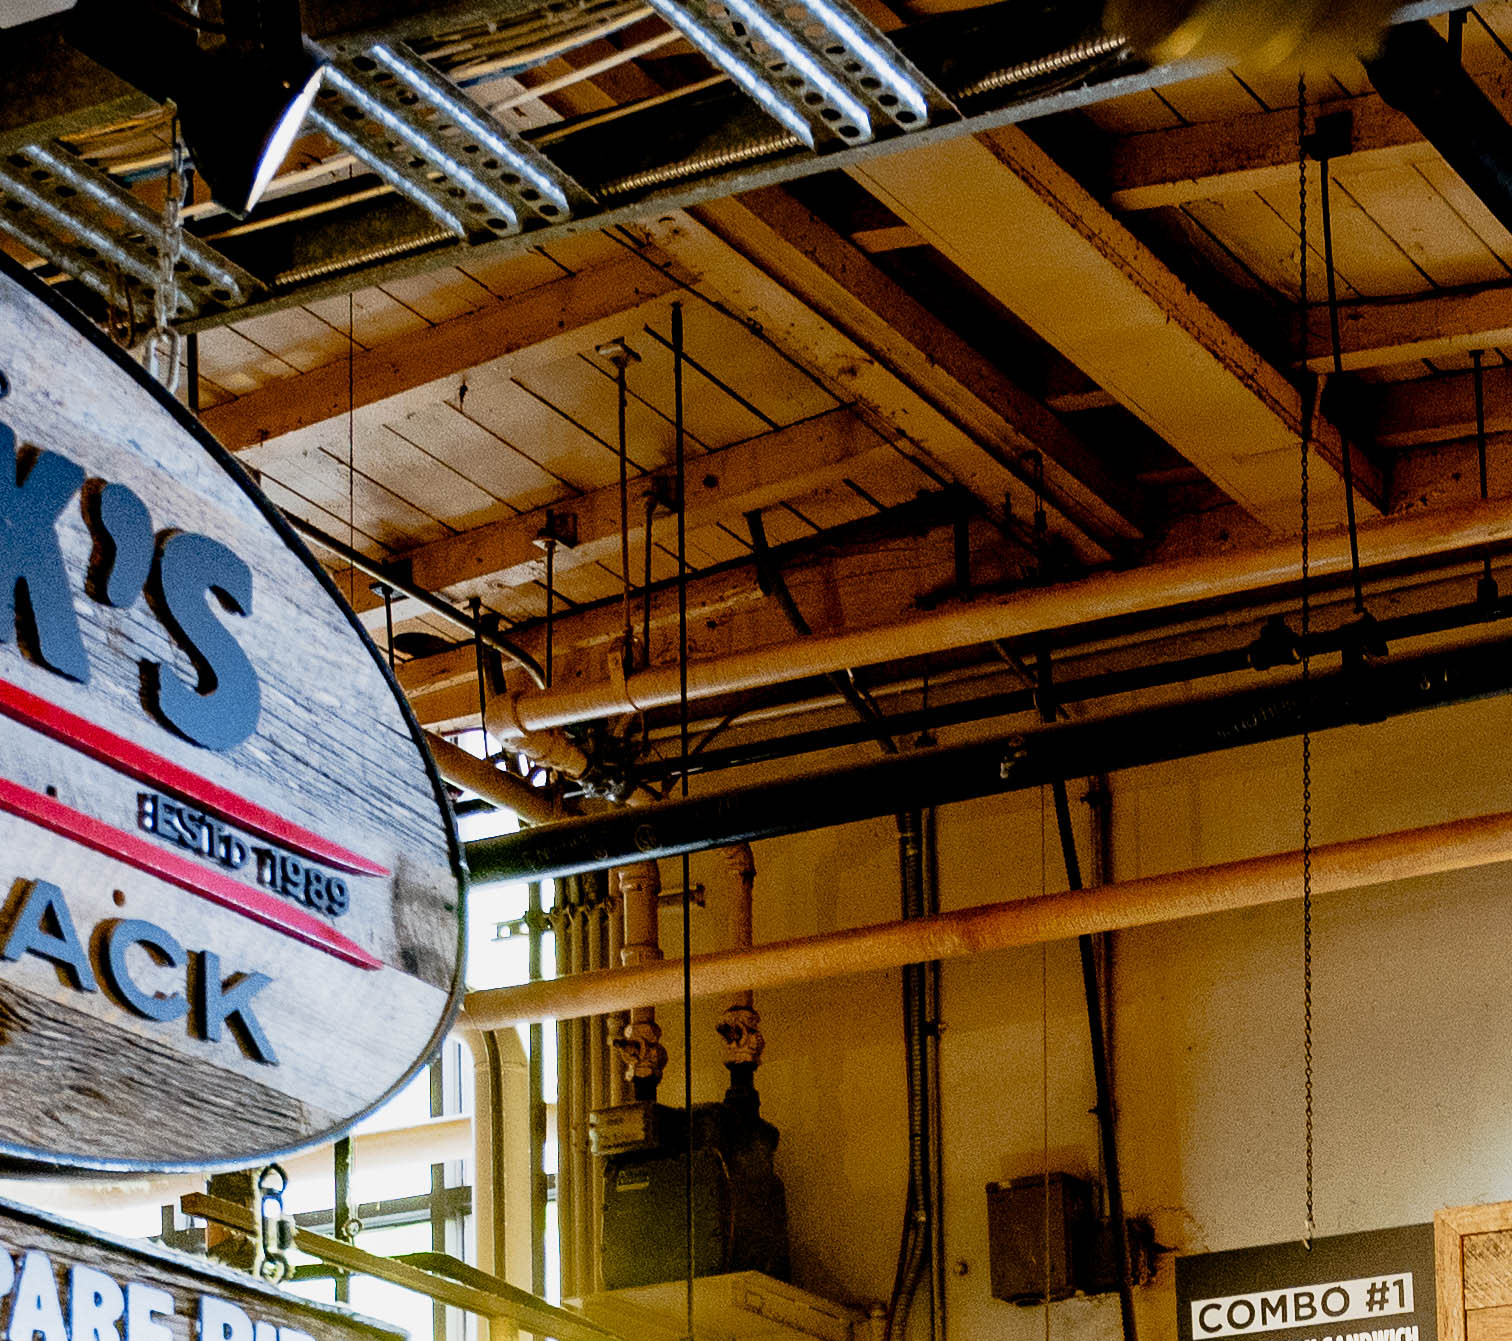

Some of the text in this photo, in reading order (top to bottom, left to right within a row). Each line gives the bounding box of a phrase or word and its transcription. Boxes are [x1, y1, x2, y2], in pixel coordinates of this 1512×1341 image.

[252, 847, 350, 917] 1989
[1198, 1280, 1410, 1333] COMBO #1
